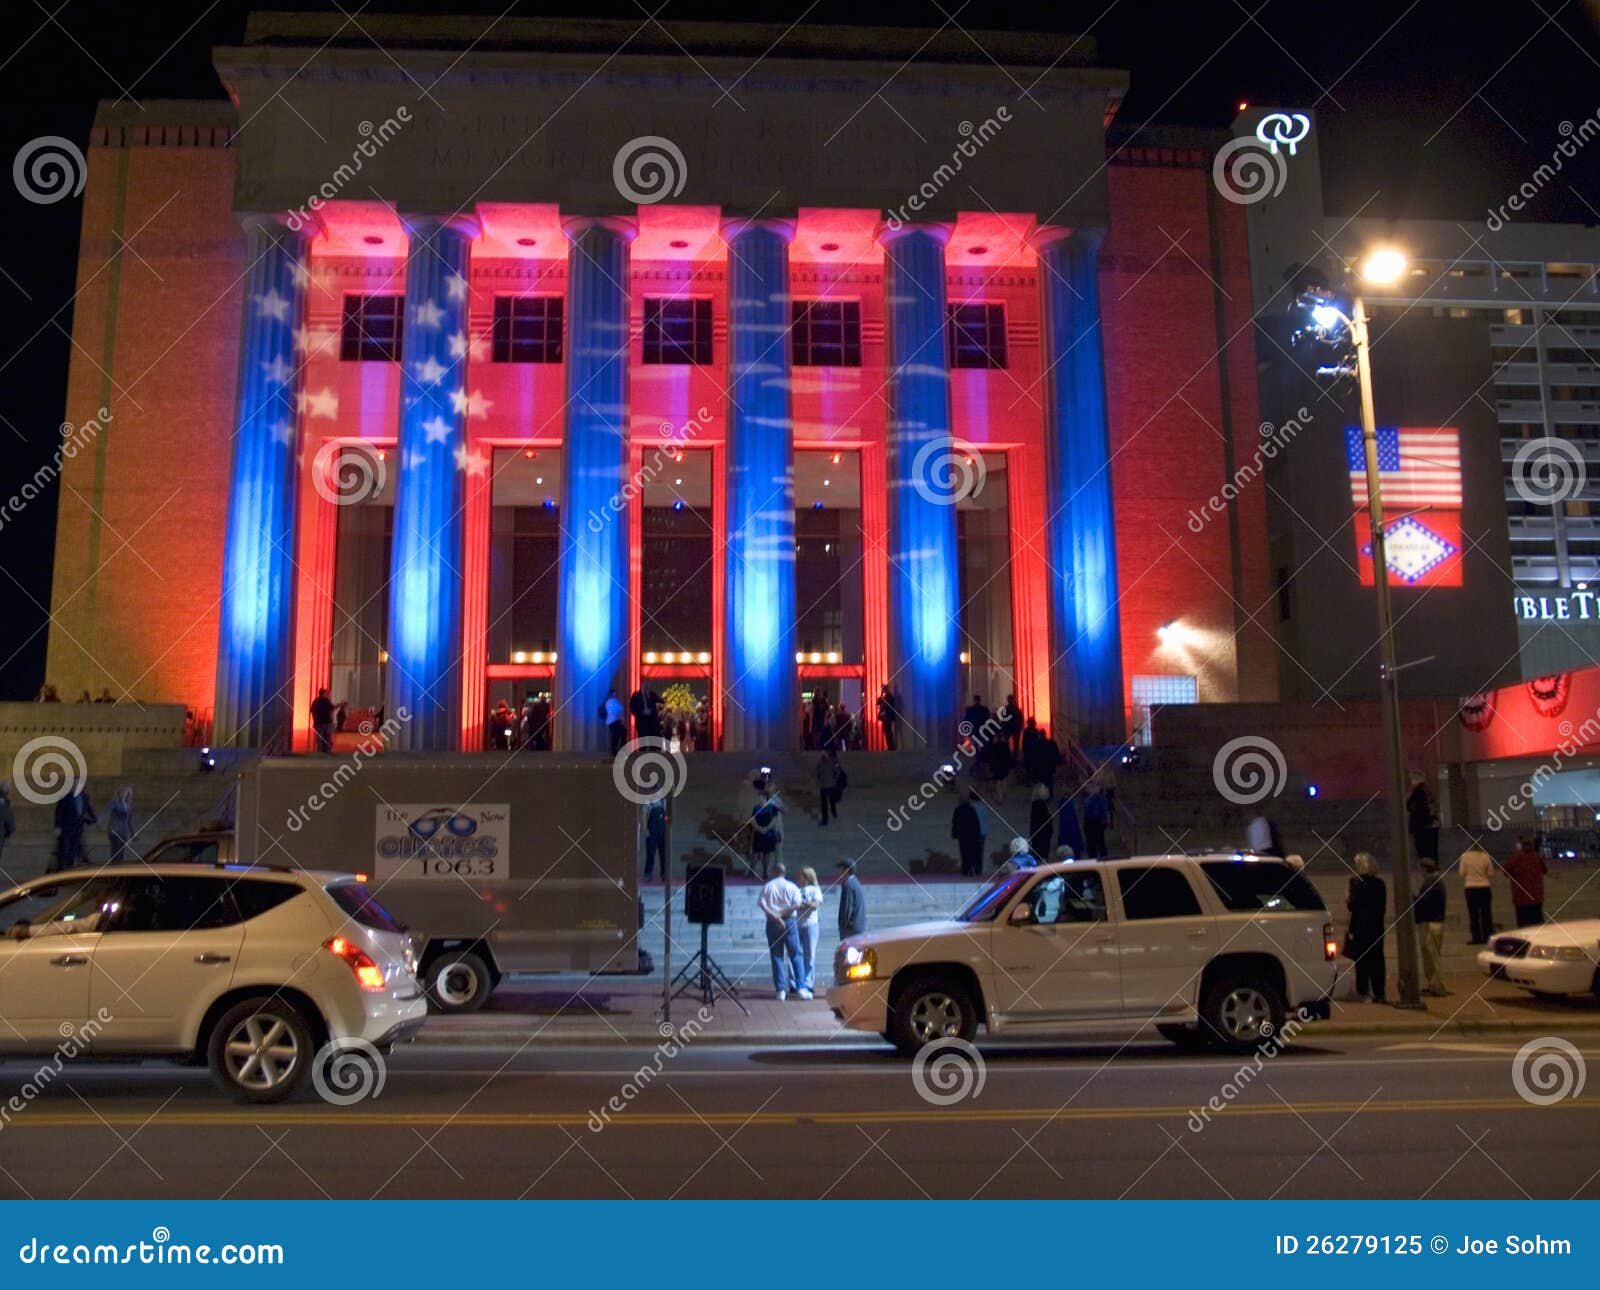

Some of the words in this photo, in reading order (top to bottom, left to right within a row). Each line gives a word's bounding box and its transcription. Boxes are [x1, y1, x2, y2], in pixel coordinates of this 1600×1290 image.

[1514, 592, 1600, 619] BLET
[479, 810, 506, 824] Now
[422, 858, 495, 876] 106.3
